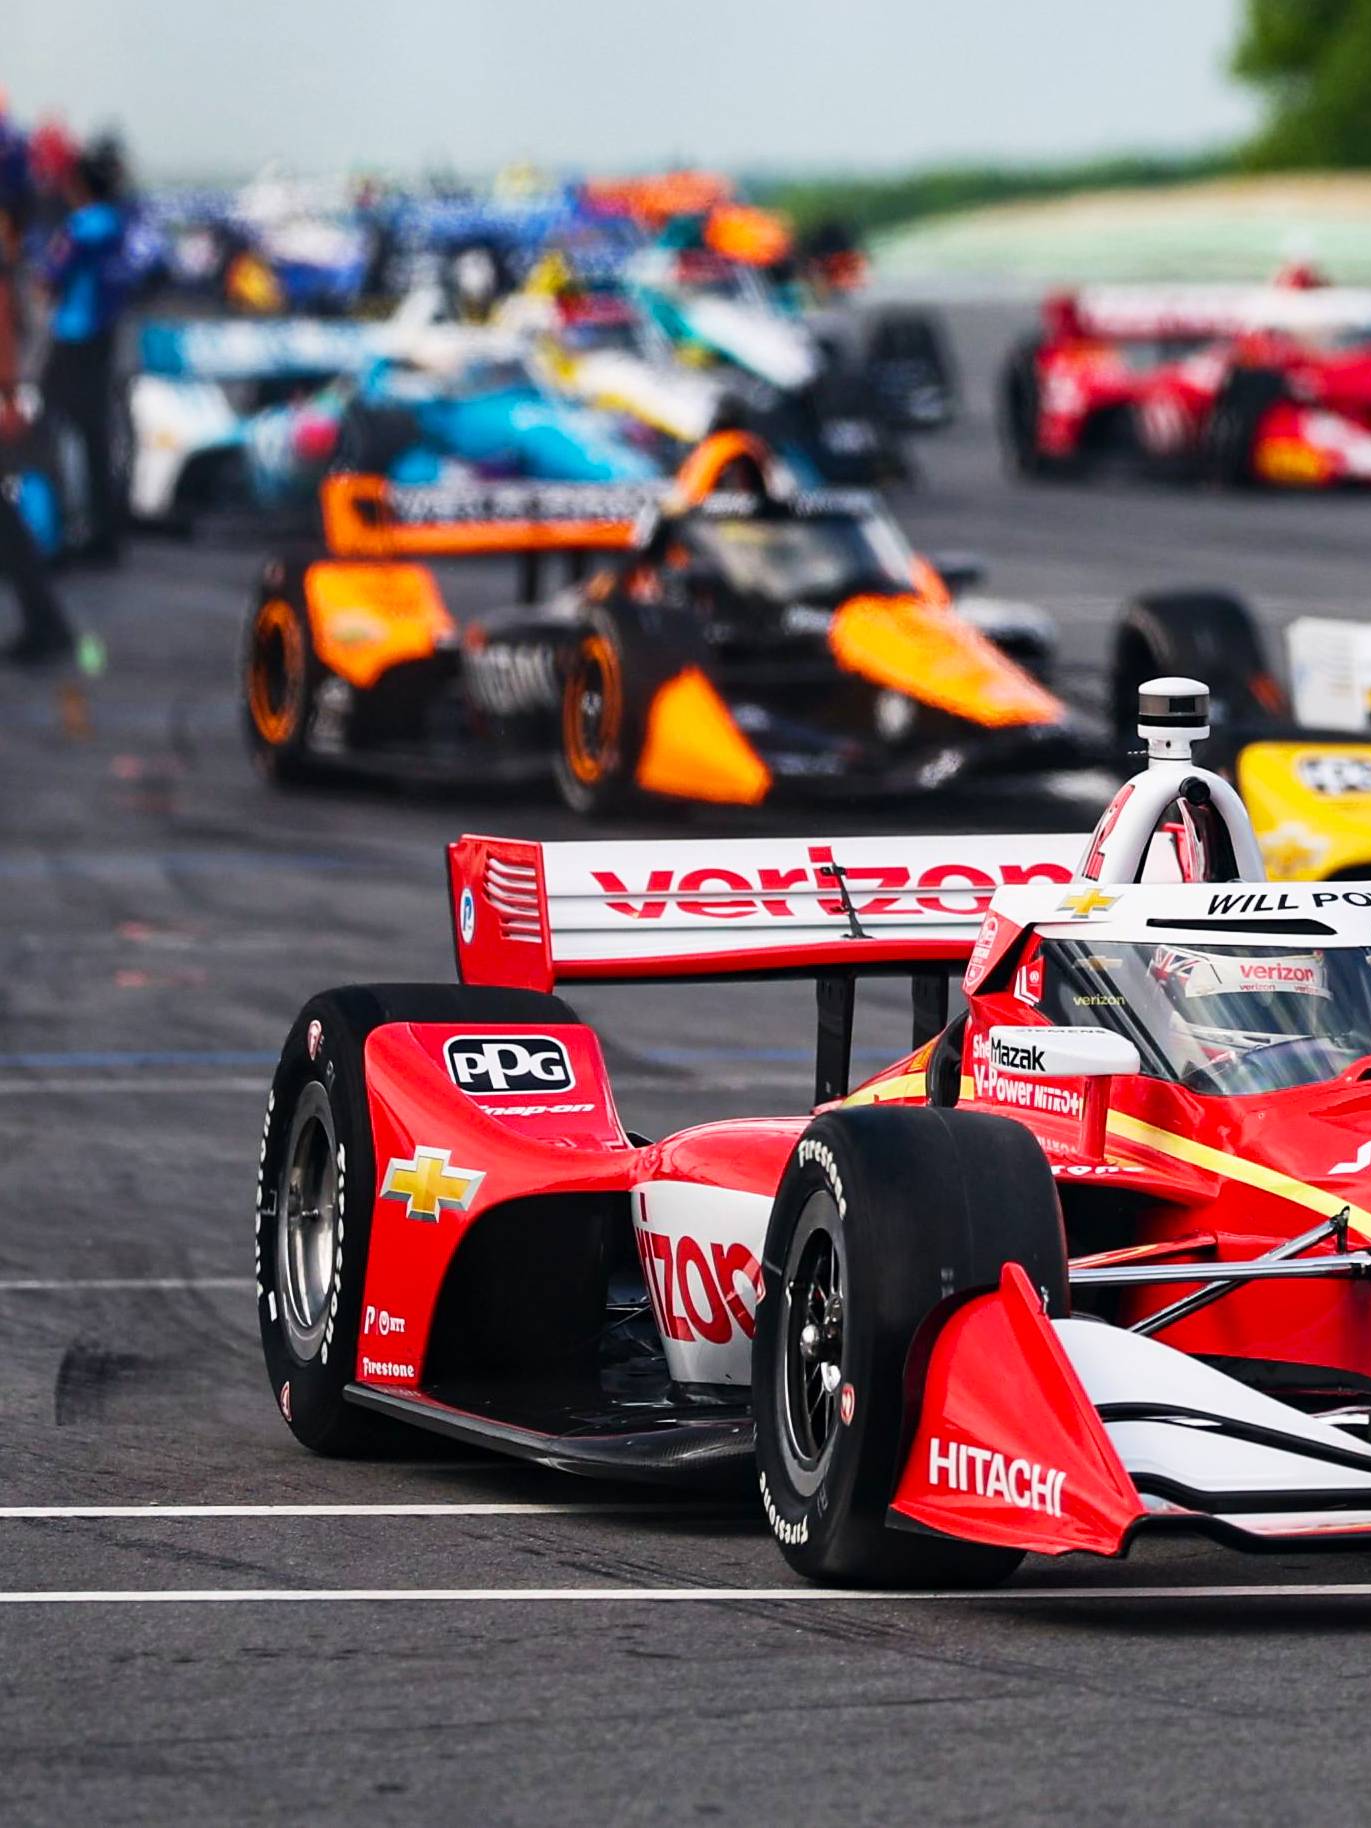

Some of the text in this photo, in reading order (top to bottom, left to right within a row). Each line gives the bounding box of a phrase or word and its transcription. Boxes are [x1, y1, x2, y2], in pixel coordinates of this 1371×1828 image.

[1207, 893, 1299, 916] WILL
[1239, 963, 1314, 982] verizon
[1073, 995, 1126, 1006] verizon
[1240, 983, 1276, 992] verizon
[973, 1033, 991, 1059] She
[991, 1036, 1047, 1072] Mazak
[453, 1043, 566, 1090] PPG
[973, 1063, 1034, 1106] V-Power
[798, 1140, 847, 1220] Firestone
[362, 1356, 415, 1378] Firestone
[929, 1437, 1066, 1518] HITACHI
